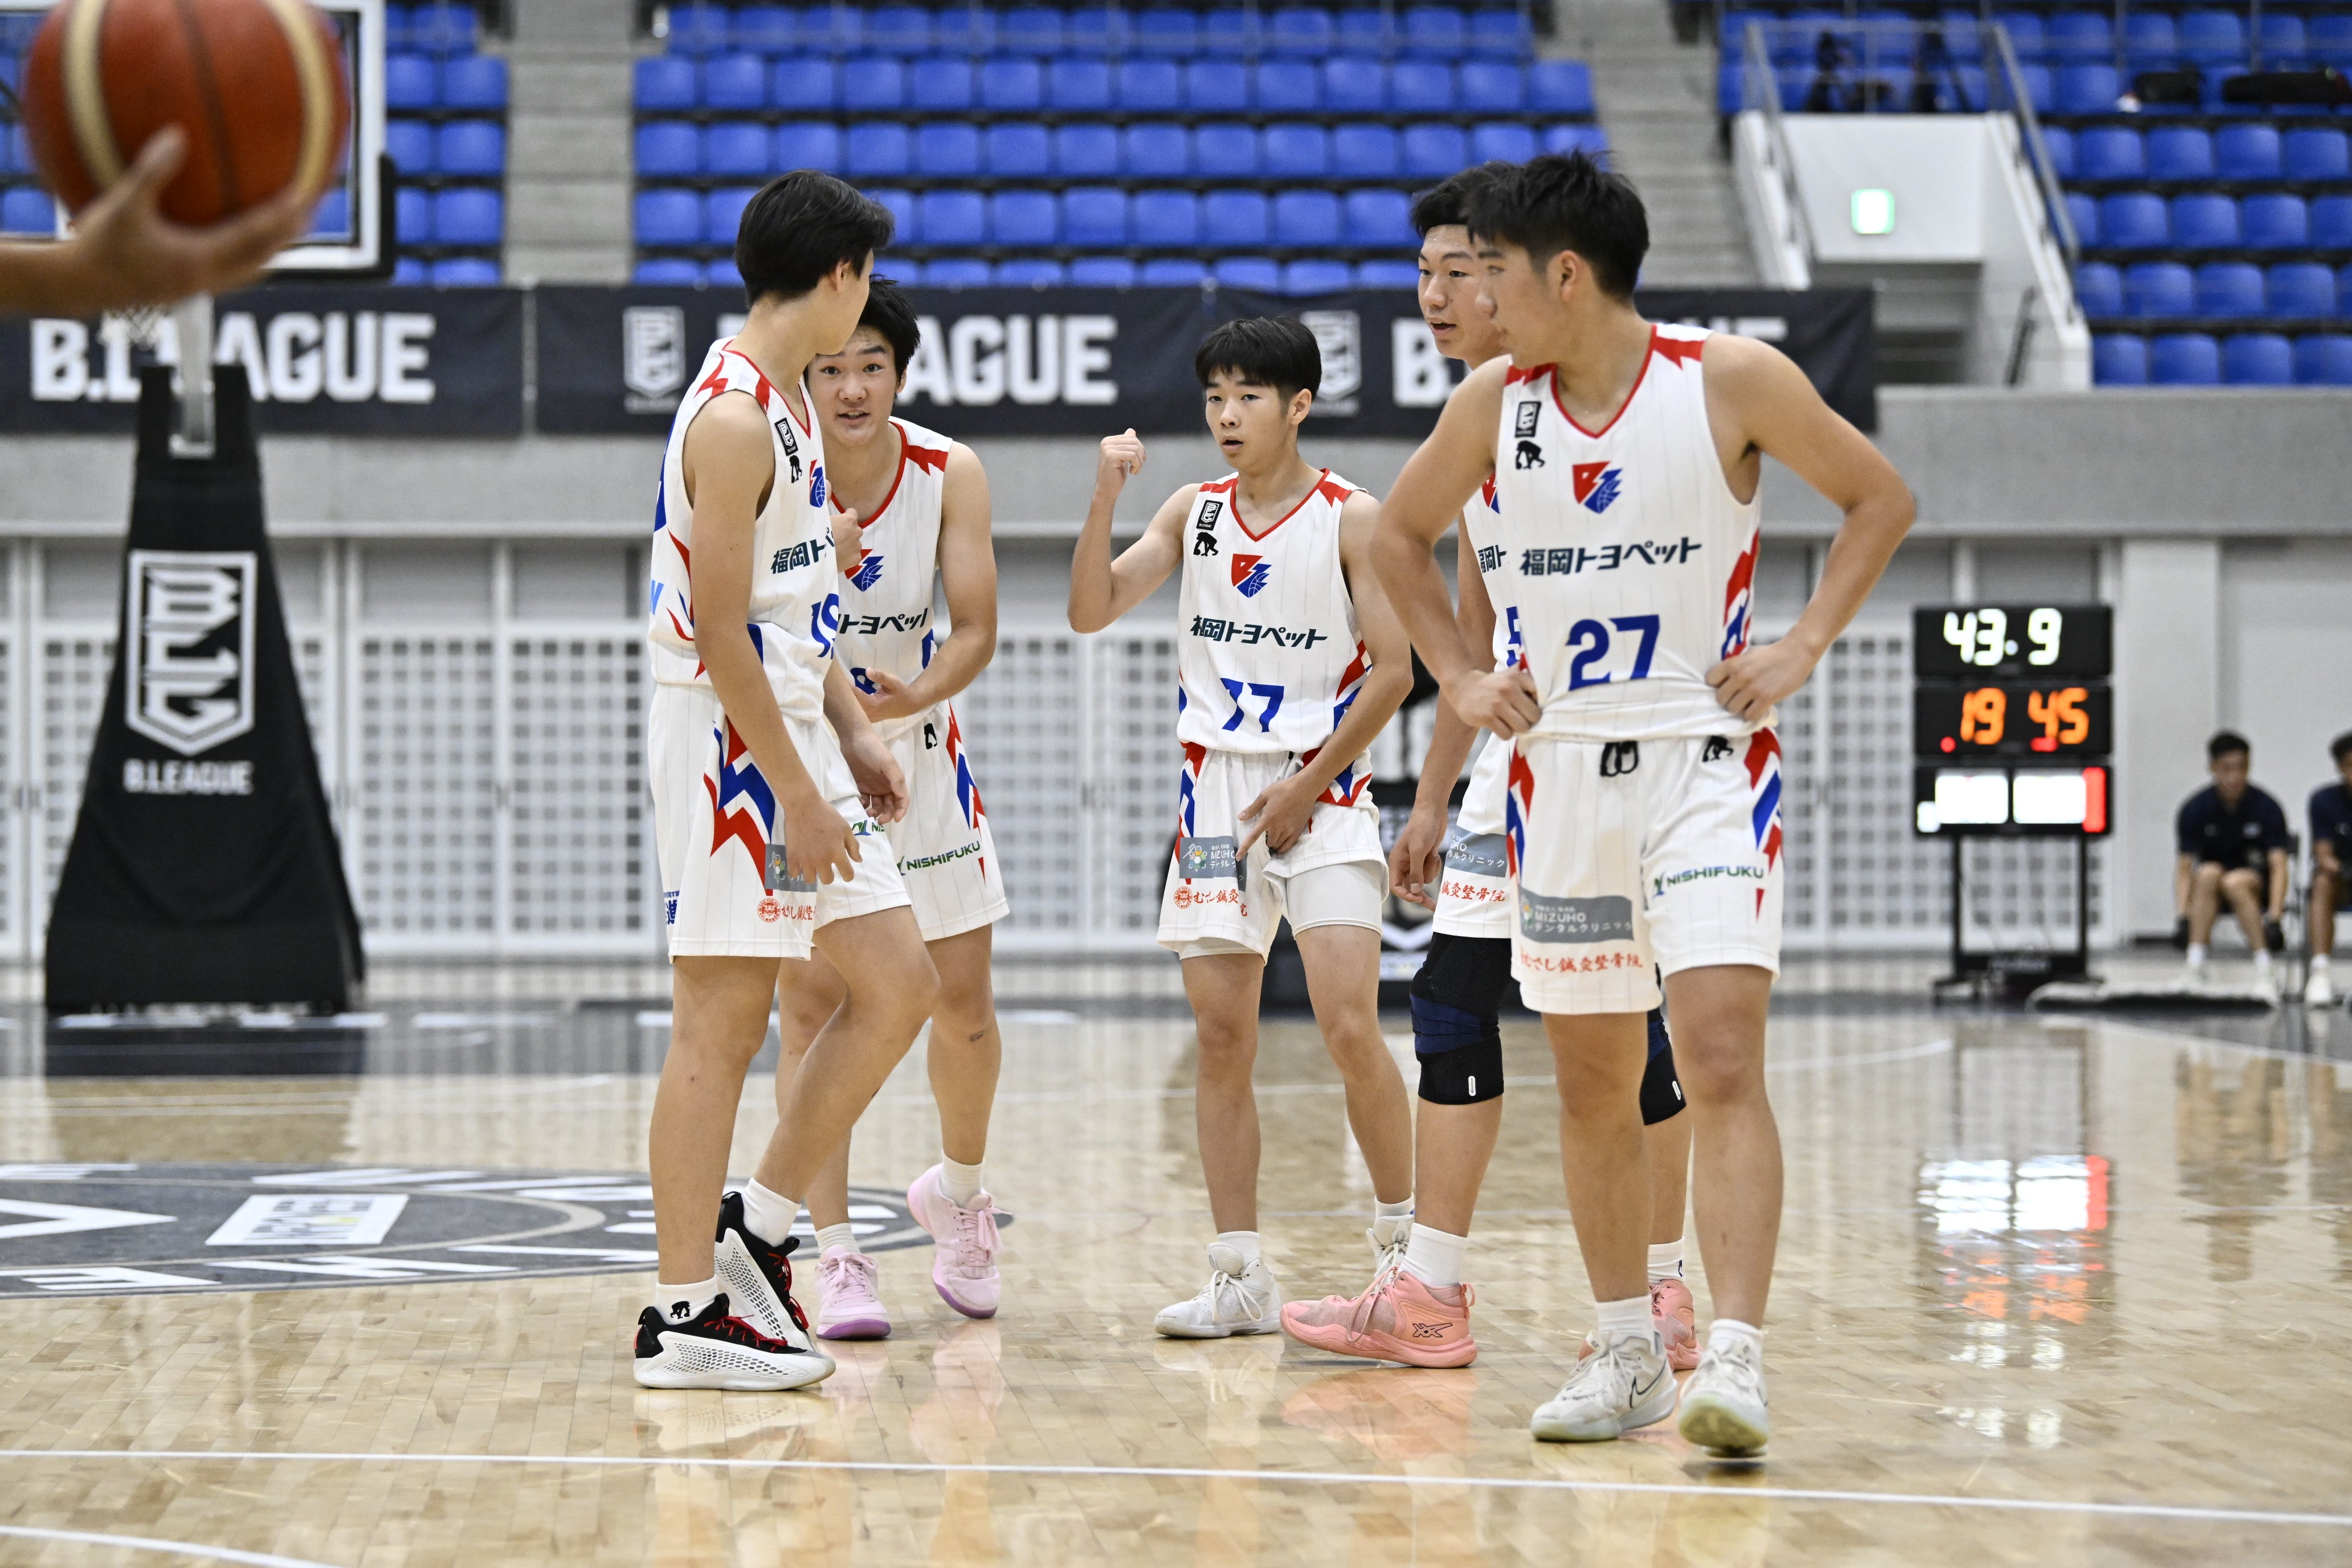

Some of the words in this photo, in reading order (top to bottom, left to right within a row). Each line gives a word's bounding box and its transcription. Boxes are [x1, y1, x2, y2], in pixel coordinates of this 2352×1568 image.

[30, 312, 436, 402] B.LAGUE
[1519, 537, 1702, 576] 福岡トヨペット
[1565, 615, 1660, 692] 27
[1959, 687, 2007, 745] 19
[2027, 687, 2089, 745] 45
[906, 840, 981, 871] NISHIFUKU
[1667, 866, 1764, 888] NISHIFUKU
